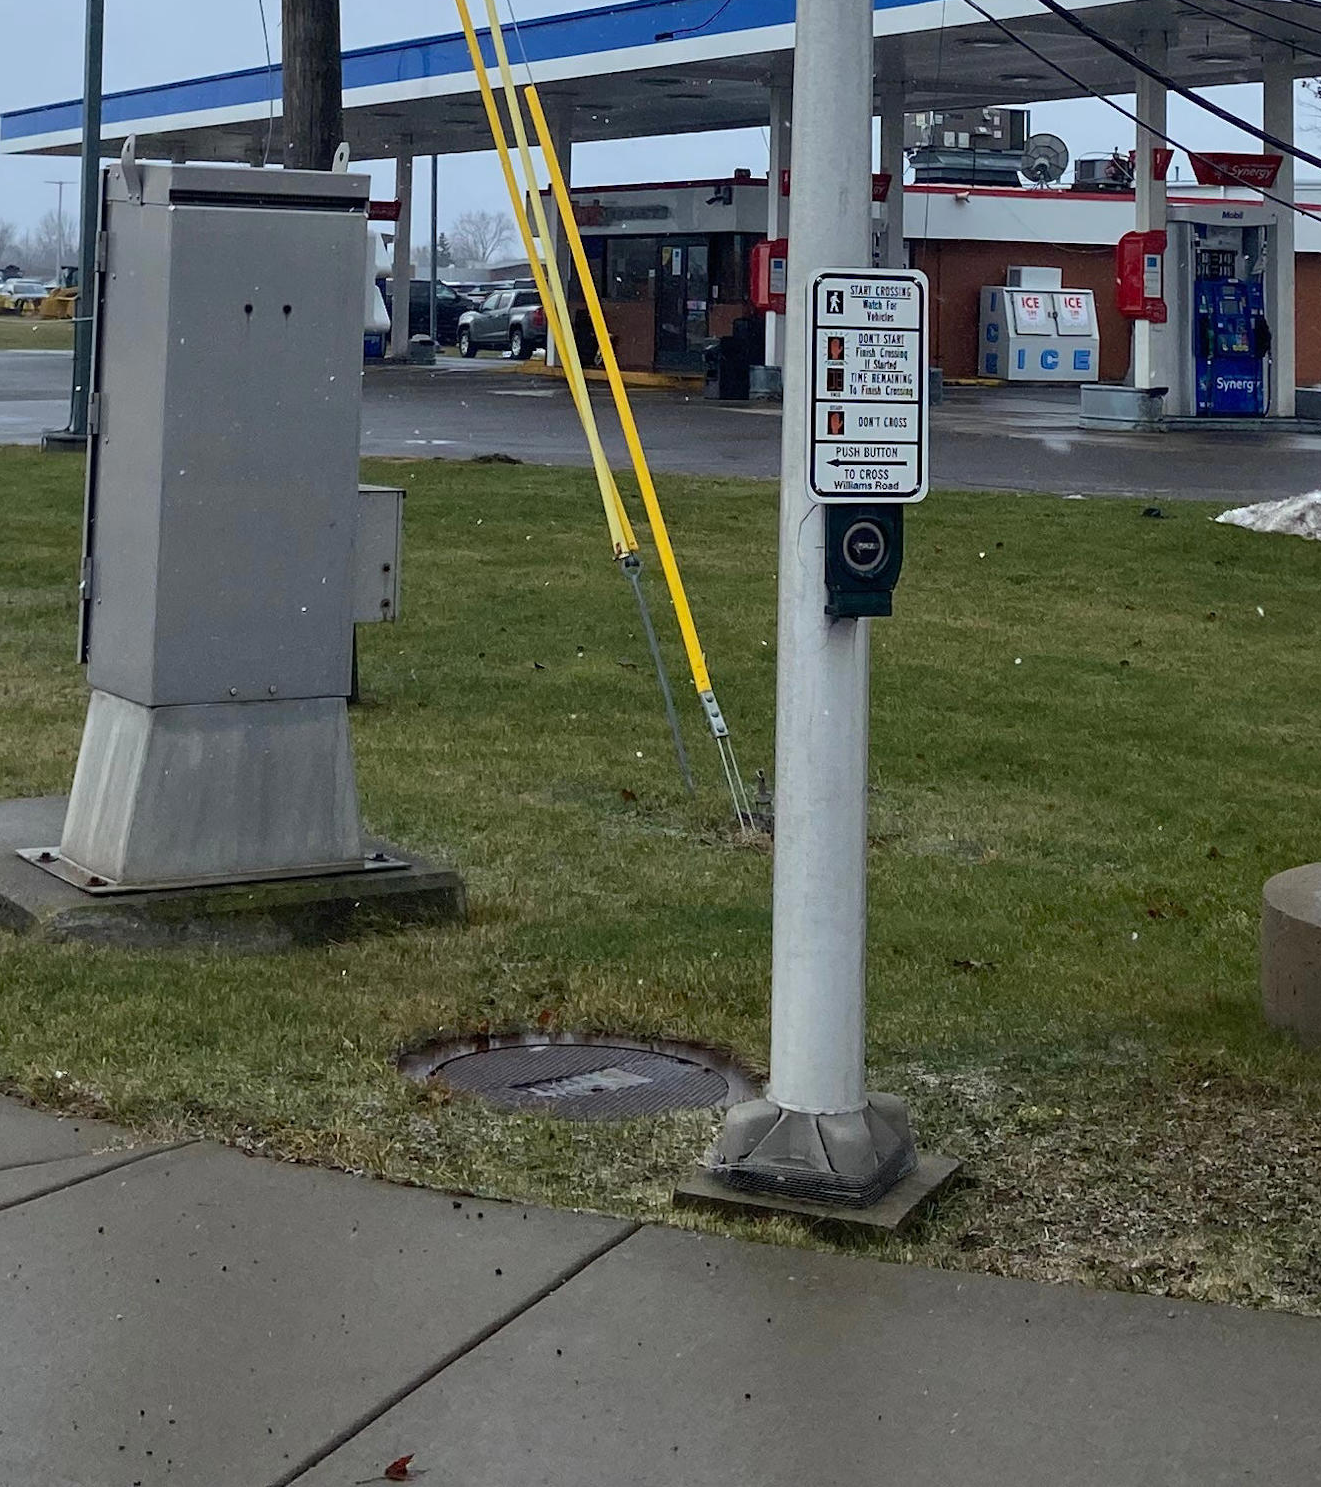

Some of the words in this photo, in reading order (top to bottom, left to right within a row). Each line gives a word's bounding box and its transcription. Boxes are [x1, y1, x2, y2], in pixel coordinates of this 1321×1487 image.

[1229, 164, 1274, 180] Synergy
[1221, 210, 1244, 220] Mobil
[850, 285, 872, 296] START
[875, 286, 911, 297] CROSSING
[863, 300, 882, 310] Watch
[886, 300, 897, 311] For
[1021, 297, 1040, 309] ICE
[1064, 297, 1083, 309] ICE
[867, 311, 895, 322] Vehicles
[858, 333, 880, 344] DON'T
[884, 334, 905, 344] START
[856, 347, 876, 358] Finish
[880, 348, 908, 361] Crossing
[1017, 348, 1091, 370] ICE
[864, 359, 870, 370] If
[873, 359, 897, 370] Started
[851, 372, 868, 383] TIME
[871, 373, 913, 384] REMAINING
[849, 384, 857, 395] To
[861, 385, 882, 396] Finish
[885, 385, 913, 398] Crossing
[858, 416, 880, 428] DON'T
[883, 417, 908, 428] CROSS
[835, 446, 860, 458] PUSH
[864, 447, 898, 458] BUTTON
[844, 468, 856, 480] TO
[859, 469, 889, 480] CROSS
[834, 481, 873, 491] Williams
[874, 481, 899, 491] Road
